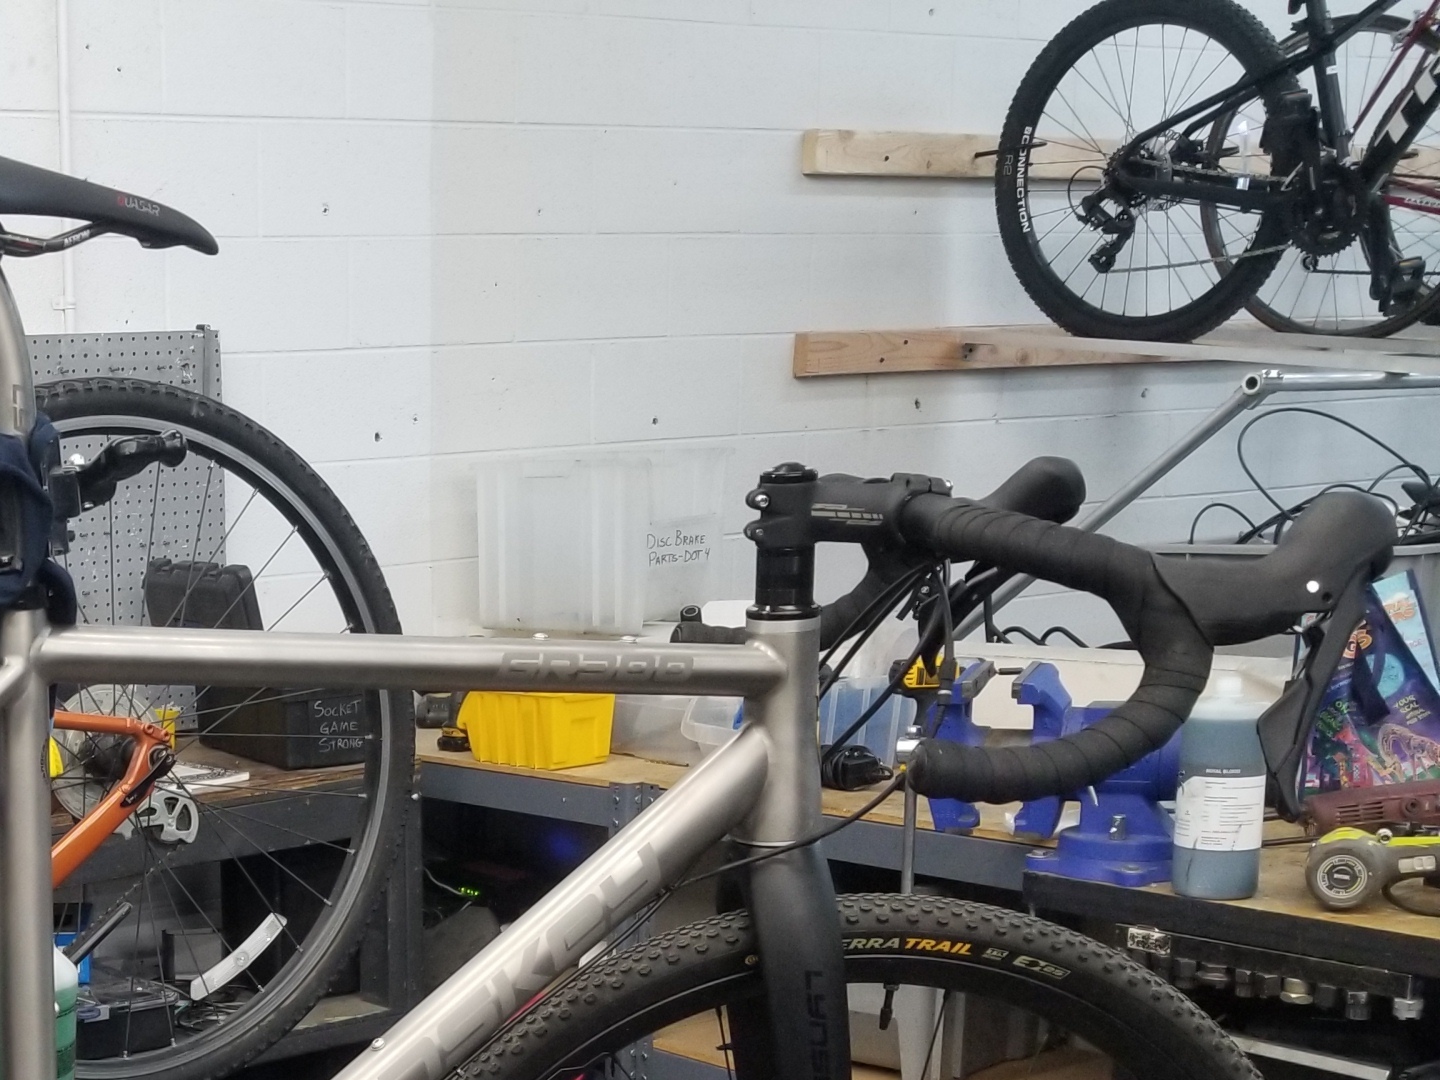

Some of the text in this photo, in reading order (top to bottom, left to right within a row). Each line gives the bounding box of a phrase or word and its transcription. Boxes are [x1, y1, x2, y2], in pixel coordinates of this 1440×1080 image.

[646, 529, 706, 550] DISC BRAKE
[704, 547, 711, 561] 4
[313, 698, 362, 718] SOCKET
[319, 720, 358, 735] GAME
[318, 737, 364, 753] STRONG
[842, 937, 973, 956] ERRA TRAIL
